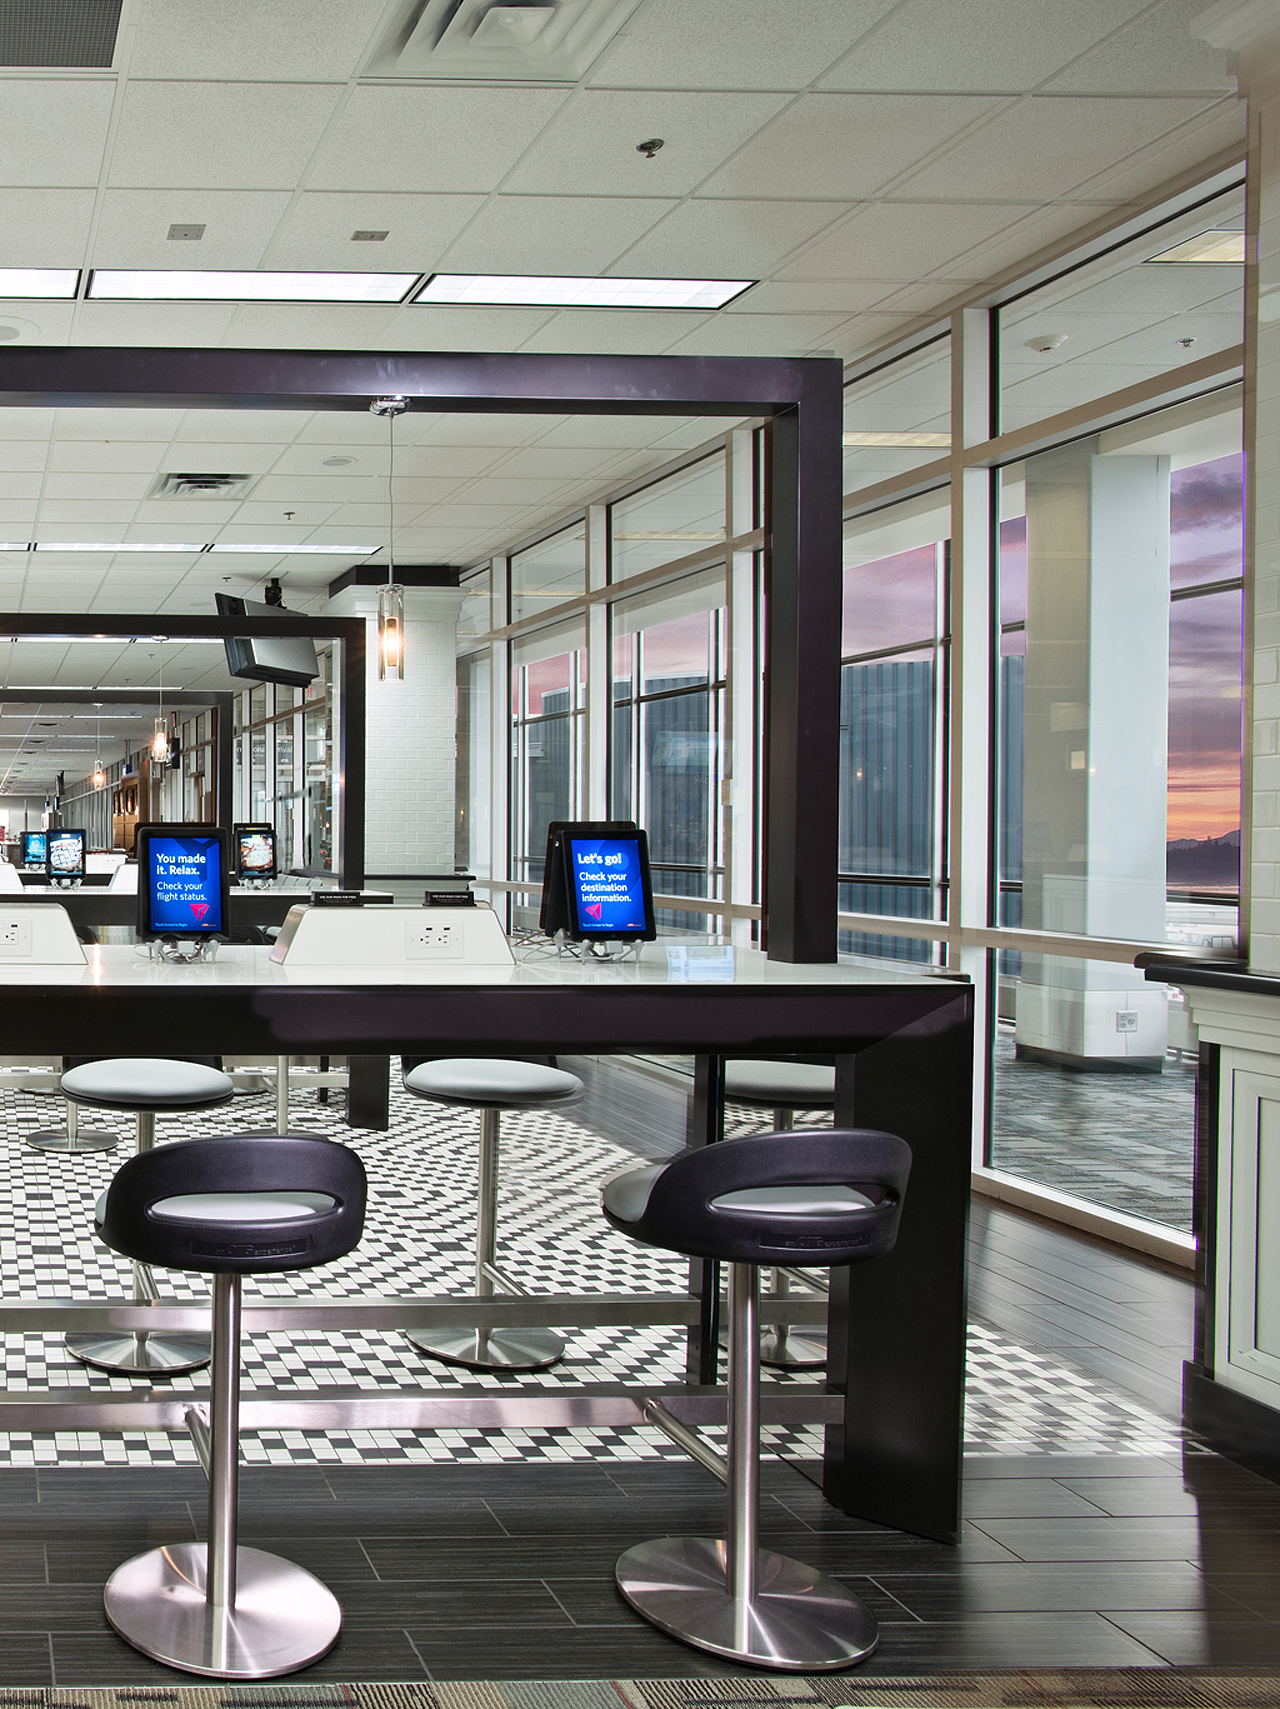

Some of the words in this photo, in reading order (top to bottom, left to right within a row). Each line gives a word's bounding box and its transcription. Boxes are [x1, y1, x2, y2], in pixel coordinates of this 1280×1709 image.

[156, 854, 175, 863] You
[178, 854, 206, 863] made
[578, 853, 603, 864] Let's
[605, 853, 622, 866] go!
[156, 865, 167, 874] it.
[170, 865, 200, 874] Relax.
[579, 872, 605, 881] Check
[607, 874, 627, 882] your
[156, 882, 182, 890] Check
[581, 883, 627, 892] destination
[156, 893, 178, 902] flight
[180, 893, 207, 901] status.
[582, 894, 632, 902] information.
